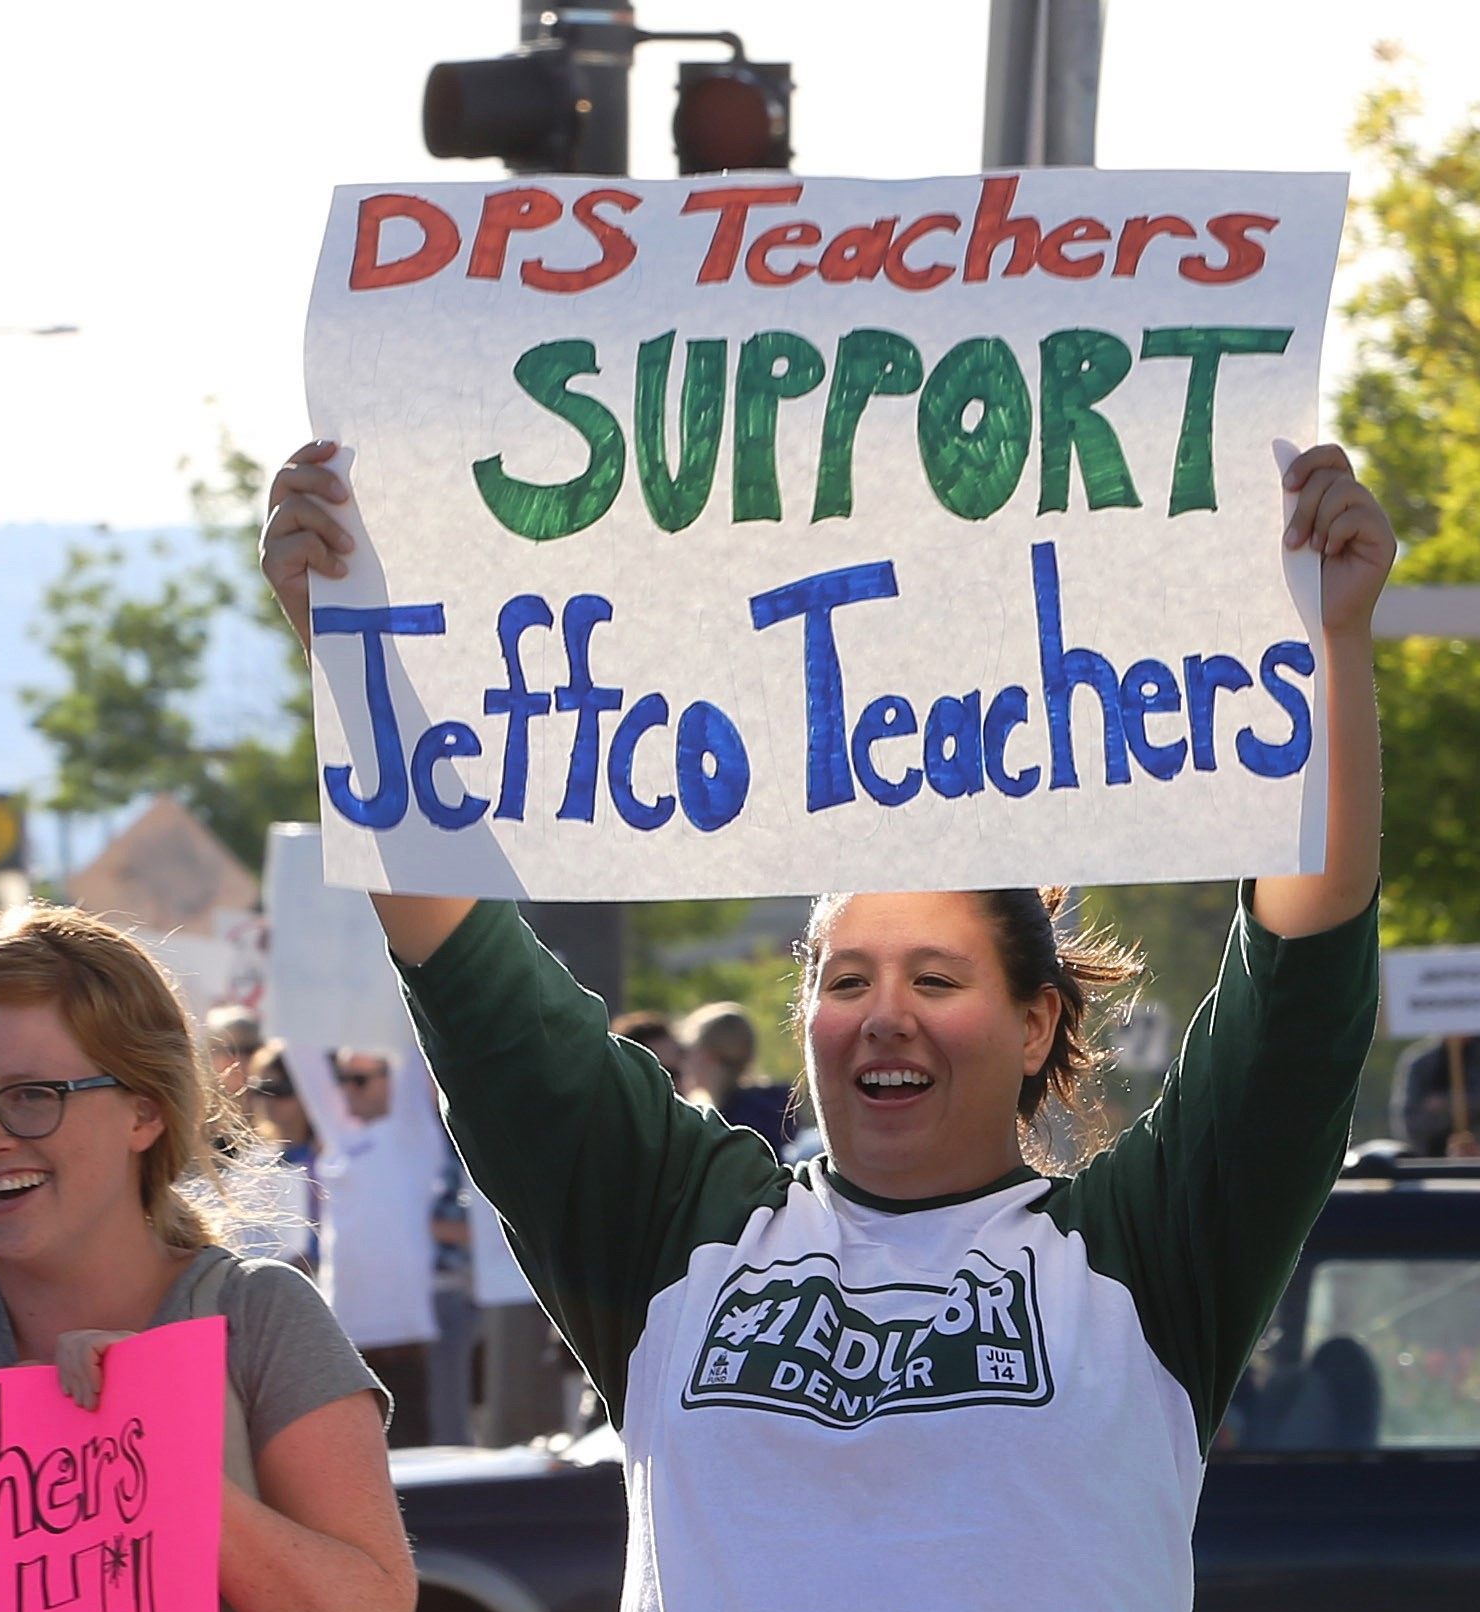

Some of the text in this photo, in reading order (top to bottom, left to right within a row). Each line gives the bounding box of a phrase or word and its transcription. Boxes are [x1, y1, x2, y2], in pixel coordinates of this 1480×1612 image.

[349, 174, 1279, 293] DPS Teachers
[472, 326, 1295, 541] SUPPORT
[311, 541, 1316, 832] Jeffco Teachers
[986, 1349, 1017, 1364] JUL
[990, 1366, 1016, 1381] 14
